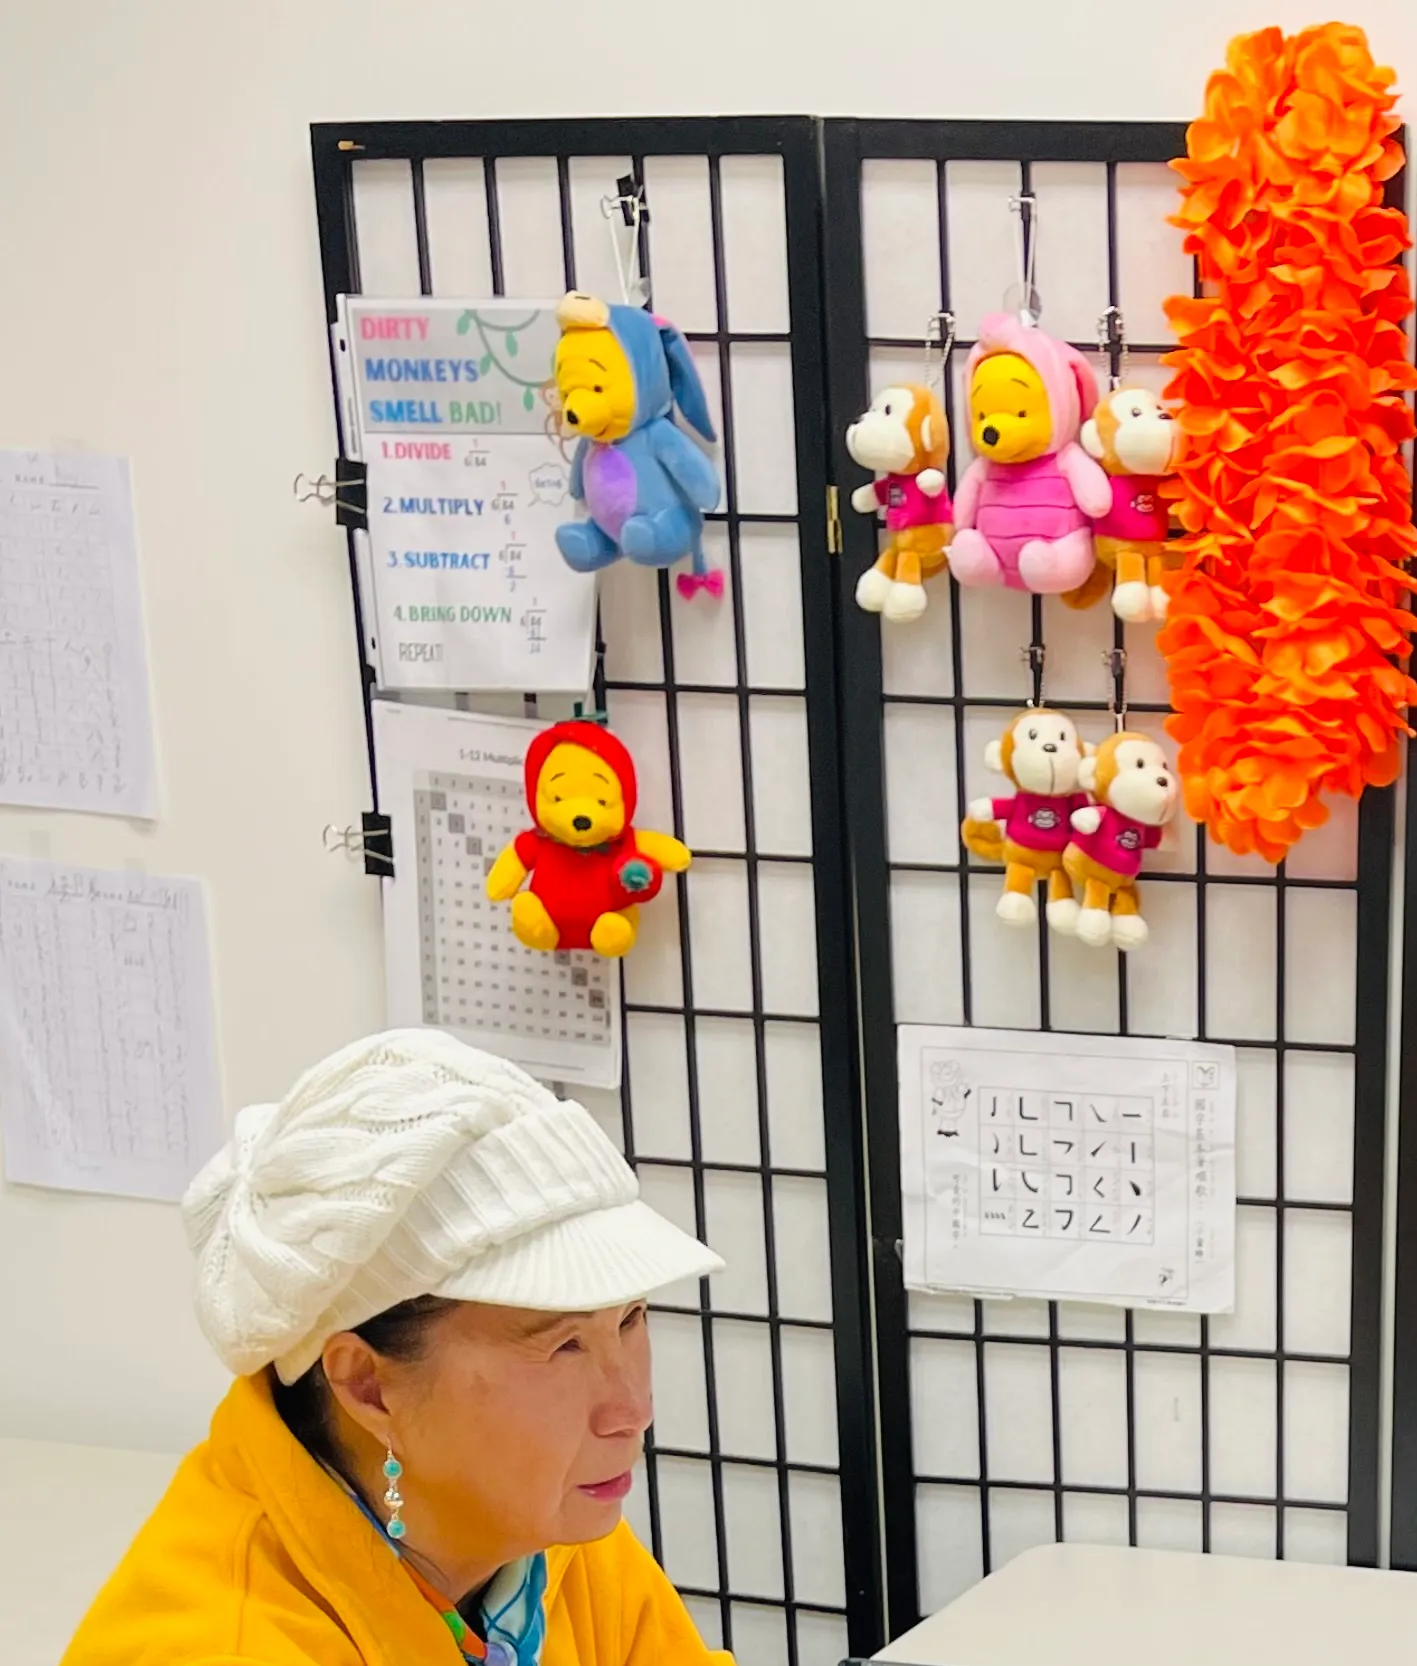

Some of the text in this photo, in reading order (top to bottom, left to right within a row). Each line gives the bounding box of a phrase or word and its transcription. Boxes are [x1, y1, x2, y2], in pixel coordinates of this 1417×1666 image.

[360, 316, 430, 341] DIRTY
[365, 357, 480, 383] MONKEYS
[370, 399, 502, 425] SMELL BAD!
[460, 605, 512, 624] DOWN
